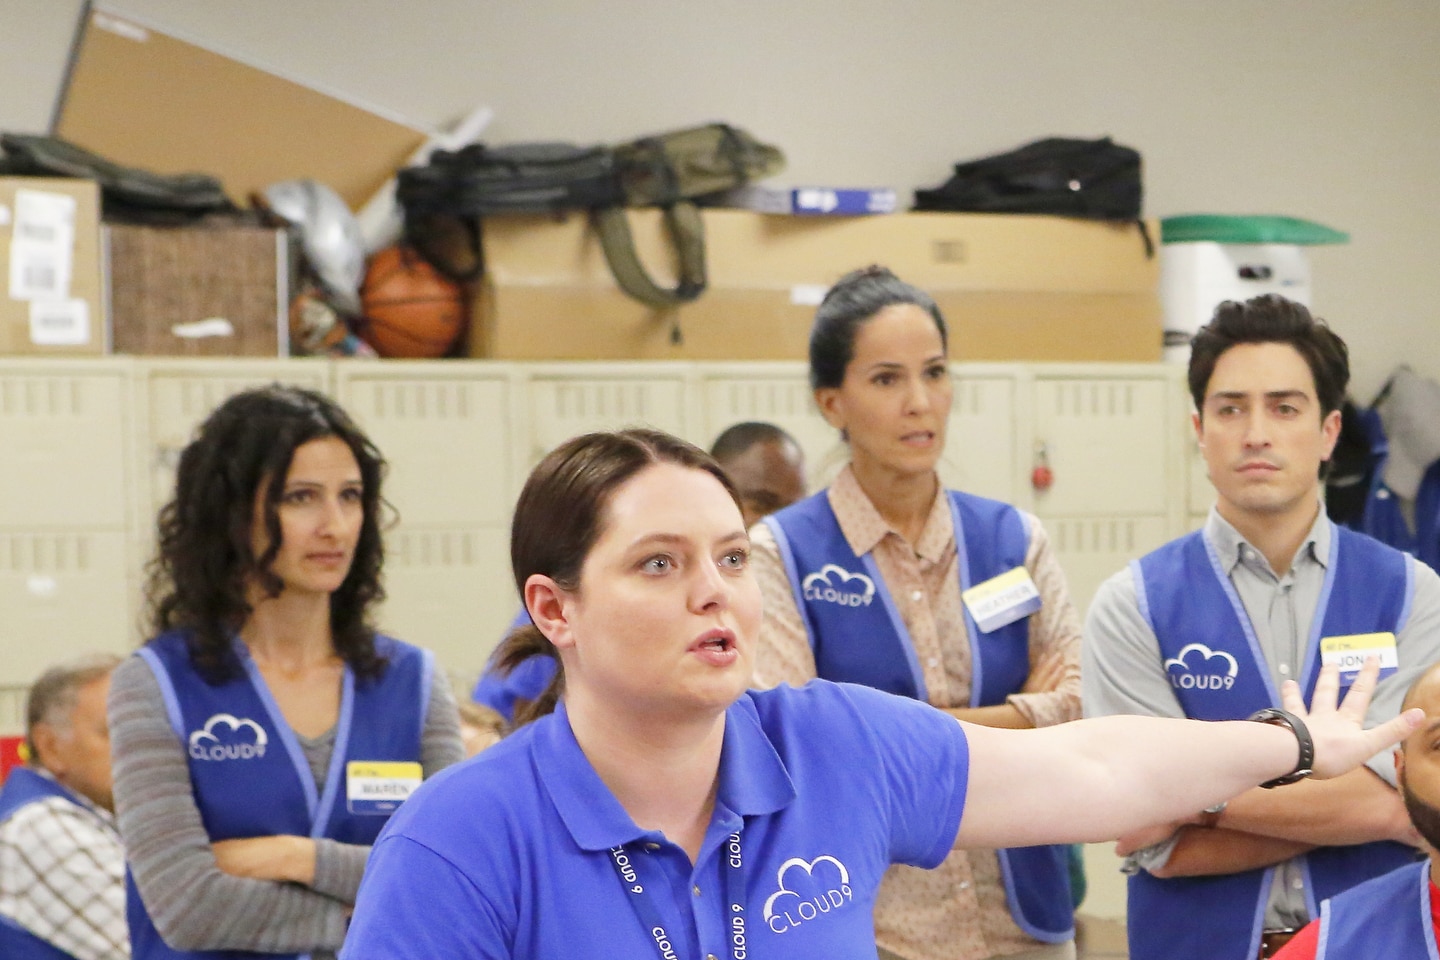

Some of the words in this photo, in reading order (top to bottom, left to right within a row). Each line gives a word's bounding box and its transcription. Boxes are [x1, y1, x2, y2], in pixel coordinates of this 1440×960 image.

[1338, 654, 1384, 667] JONH
[1171, 673, 1235, 690] LOUD9
[730, 830, 741, 868] CLOU
[631, 885, 643, 893] 9
[732, 904, 744, 912] 9
[770, 885, 852, 934] CLOUD9
[733, 916, 746, 960] CLOUD
